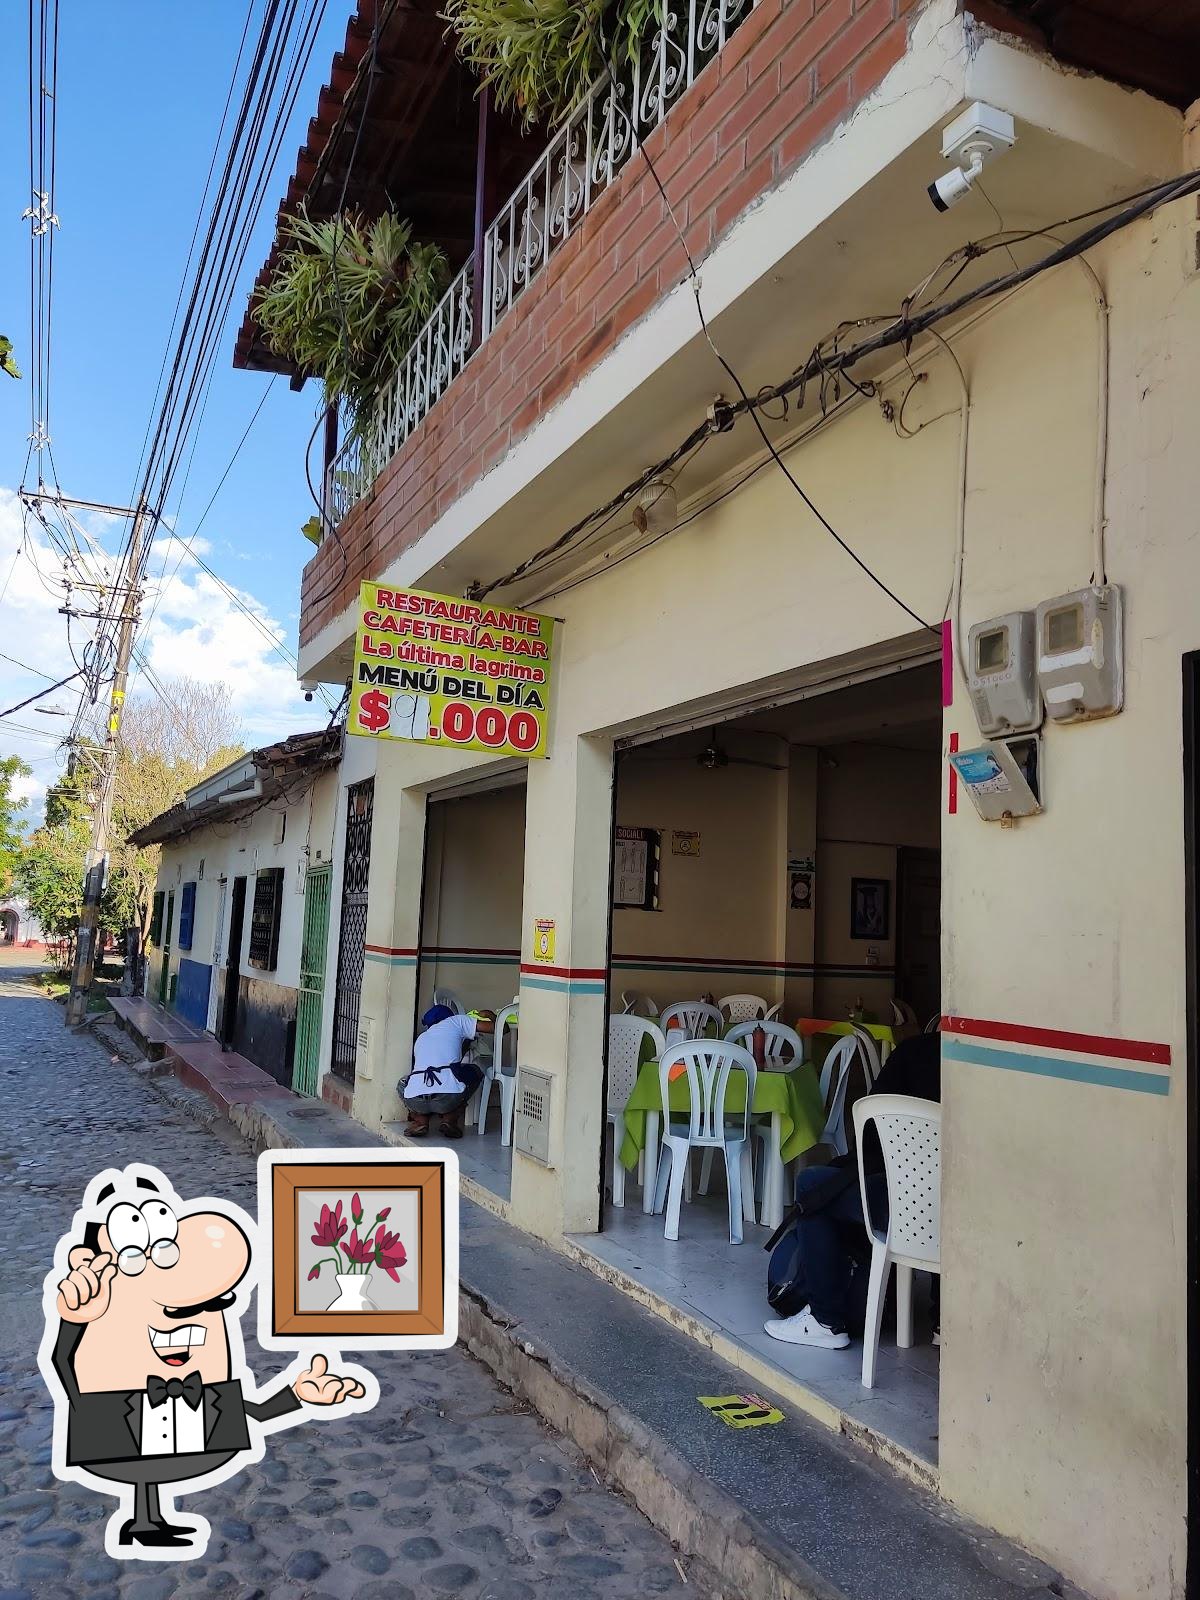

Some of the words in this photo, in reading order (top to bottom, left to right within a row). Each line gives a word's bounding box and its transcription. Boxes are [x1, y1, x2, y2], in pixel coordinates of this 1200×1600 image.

[363, 611, 548, 658] CAFETERÍA-BAR
[377, 589, 540, 635] RESTAURANTE
[362, 635, 393, 657] La
[397, 641, 465, 671] última
[469, 654, 545, 683] lagrima
[358, 662, 438, 694] MENÚ
[441, 676, 493, 703] DEL
[496, 682, 545, 711] DÍA
